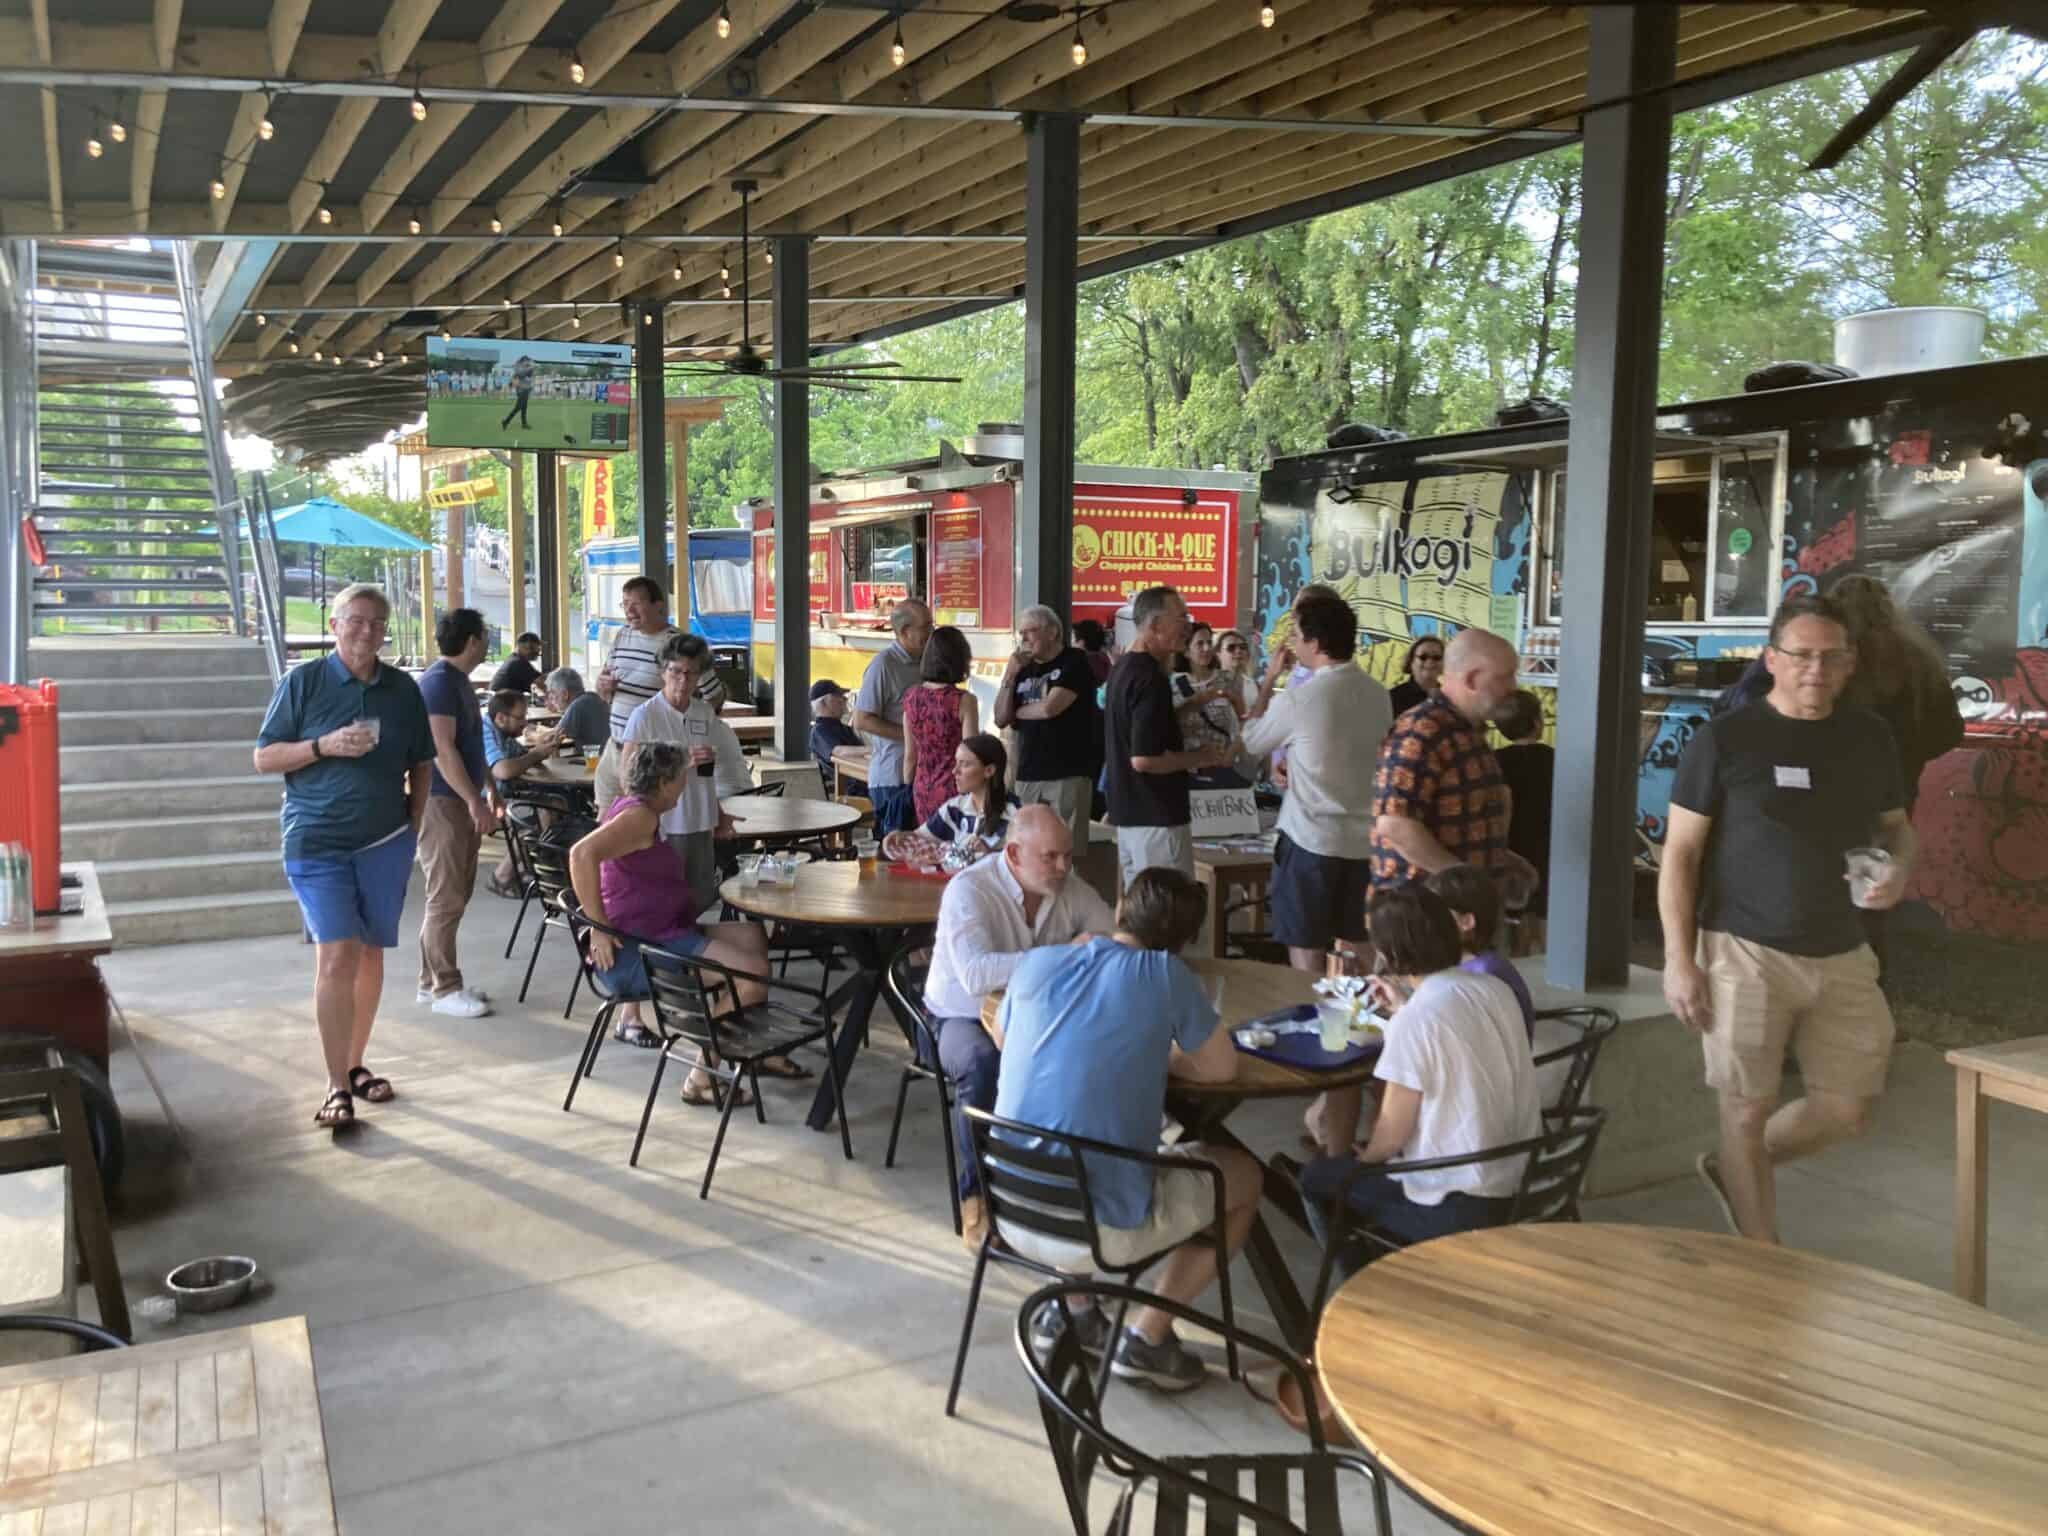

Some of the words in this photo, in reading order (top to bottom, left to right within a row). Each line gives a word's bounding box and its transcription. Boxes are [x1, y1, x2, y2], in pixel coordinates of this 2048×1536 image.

[1101, 530, 1217, 562] CHICK-N-QUE
[1323, 505, 1474, 586] Bulkogi
[1099, 561, 1144, 573] Chopped
[1145, 562, 1184, 571] Chicken
